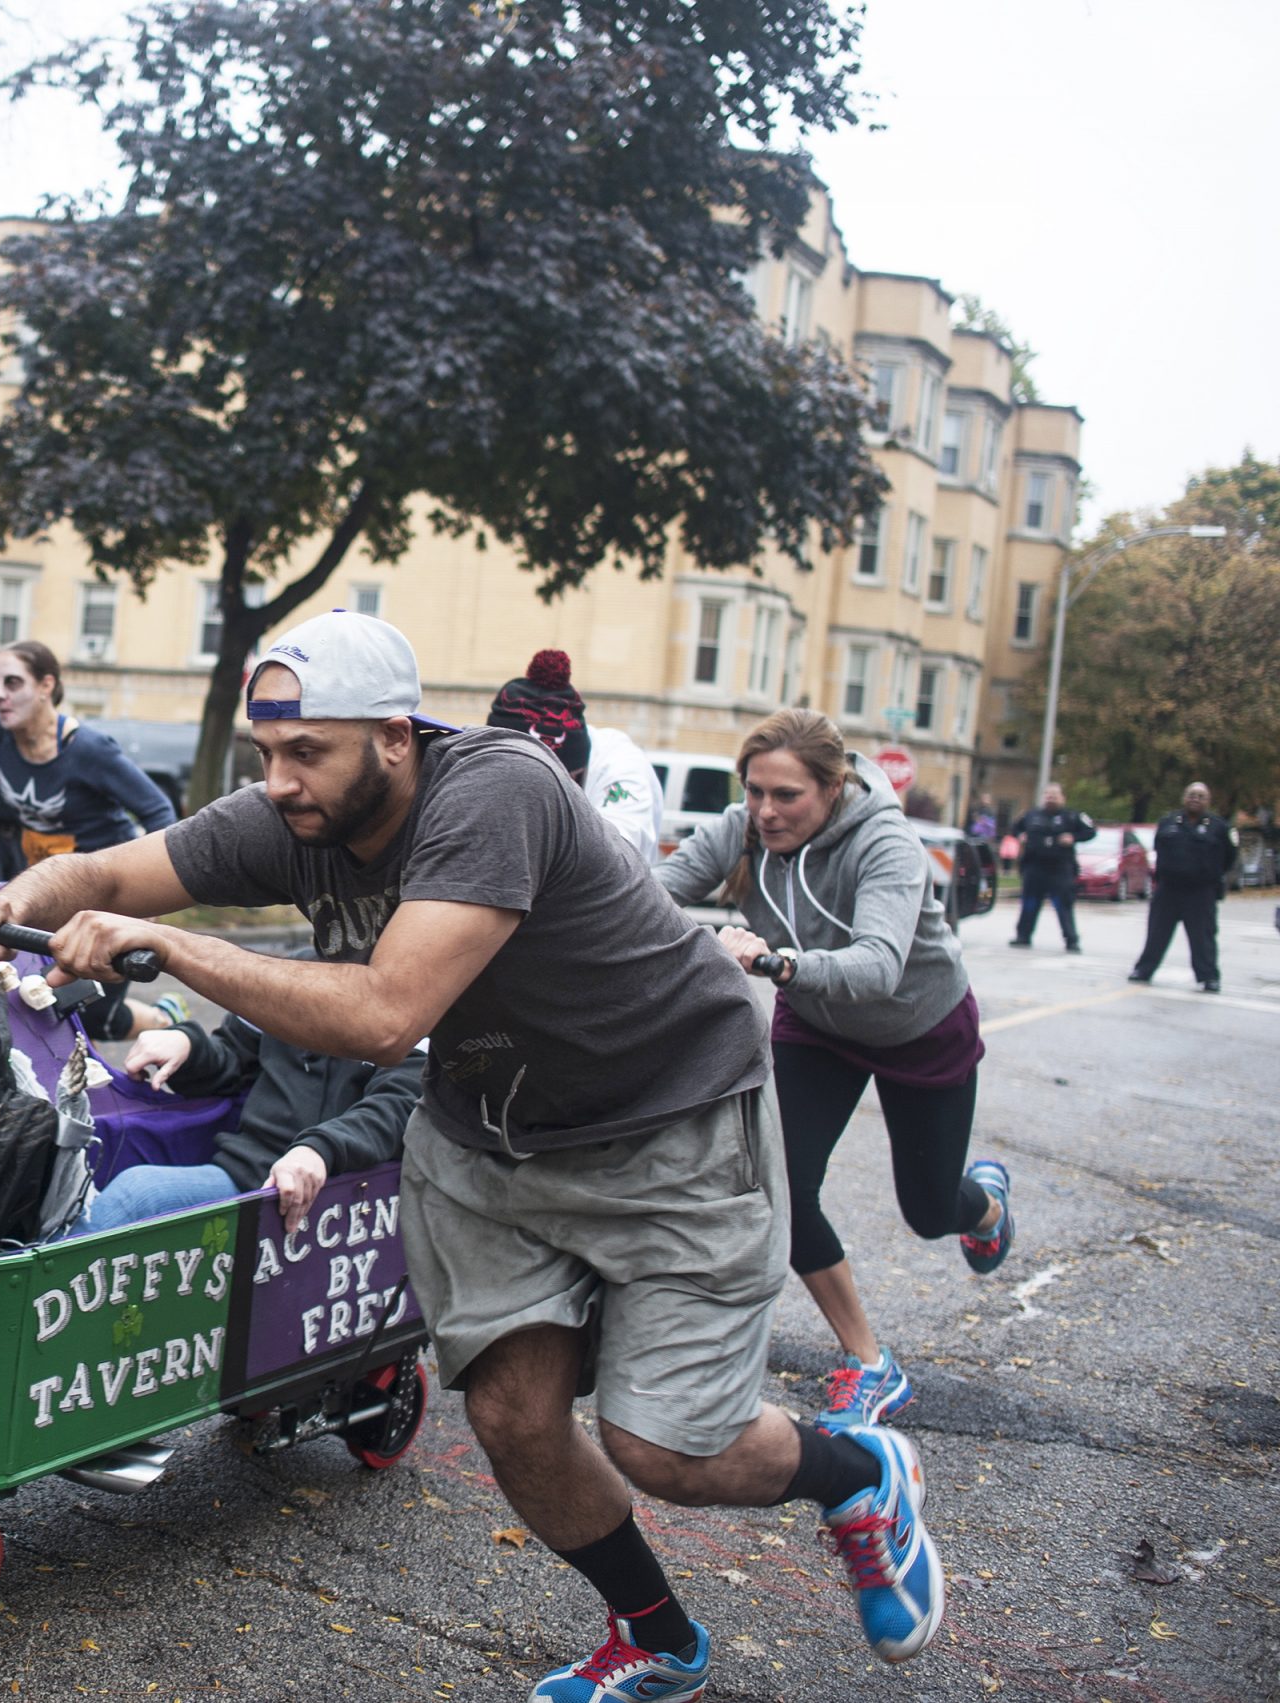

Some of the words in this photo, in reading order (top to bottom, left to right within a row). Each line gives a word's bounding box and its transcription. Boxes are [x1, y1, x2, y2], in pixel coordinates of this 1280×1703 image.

[33, 1247, 235, 1344] DUFFYS
[326, 1249, 379, 1300] BY
[29, 1327, 226, 1429] TAVERN
